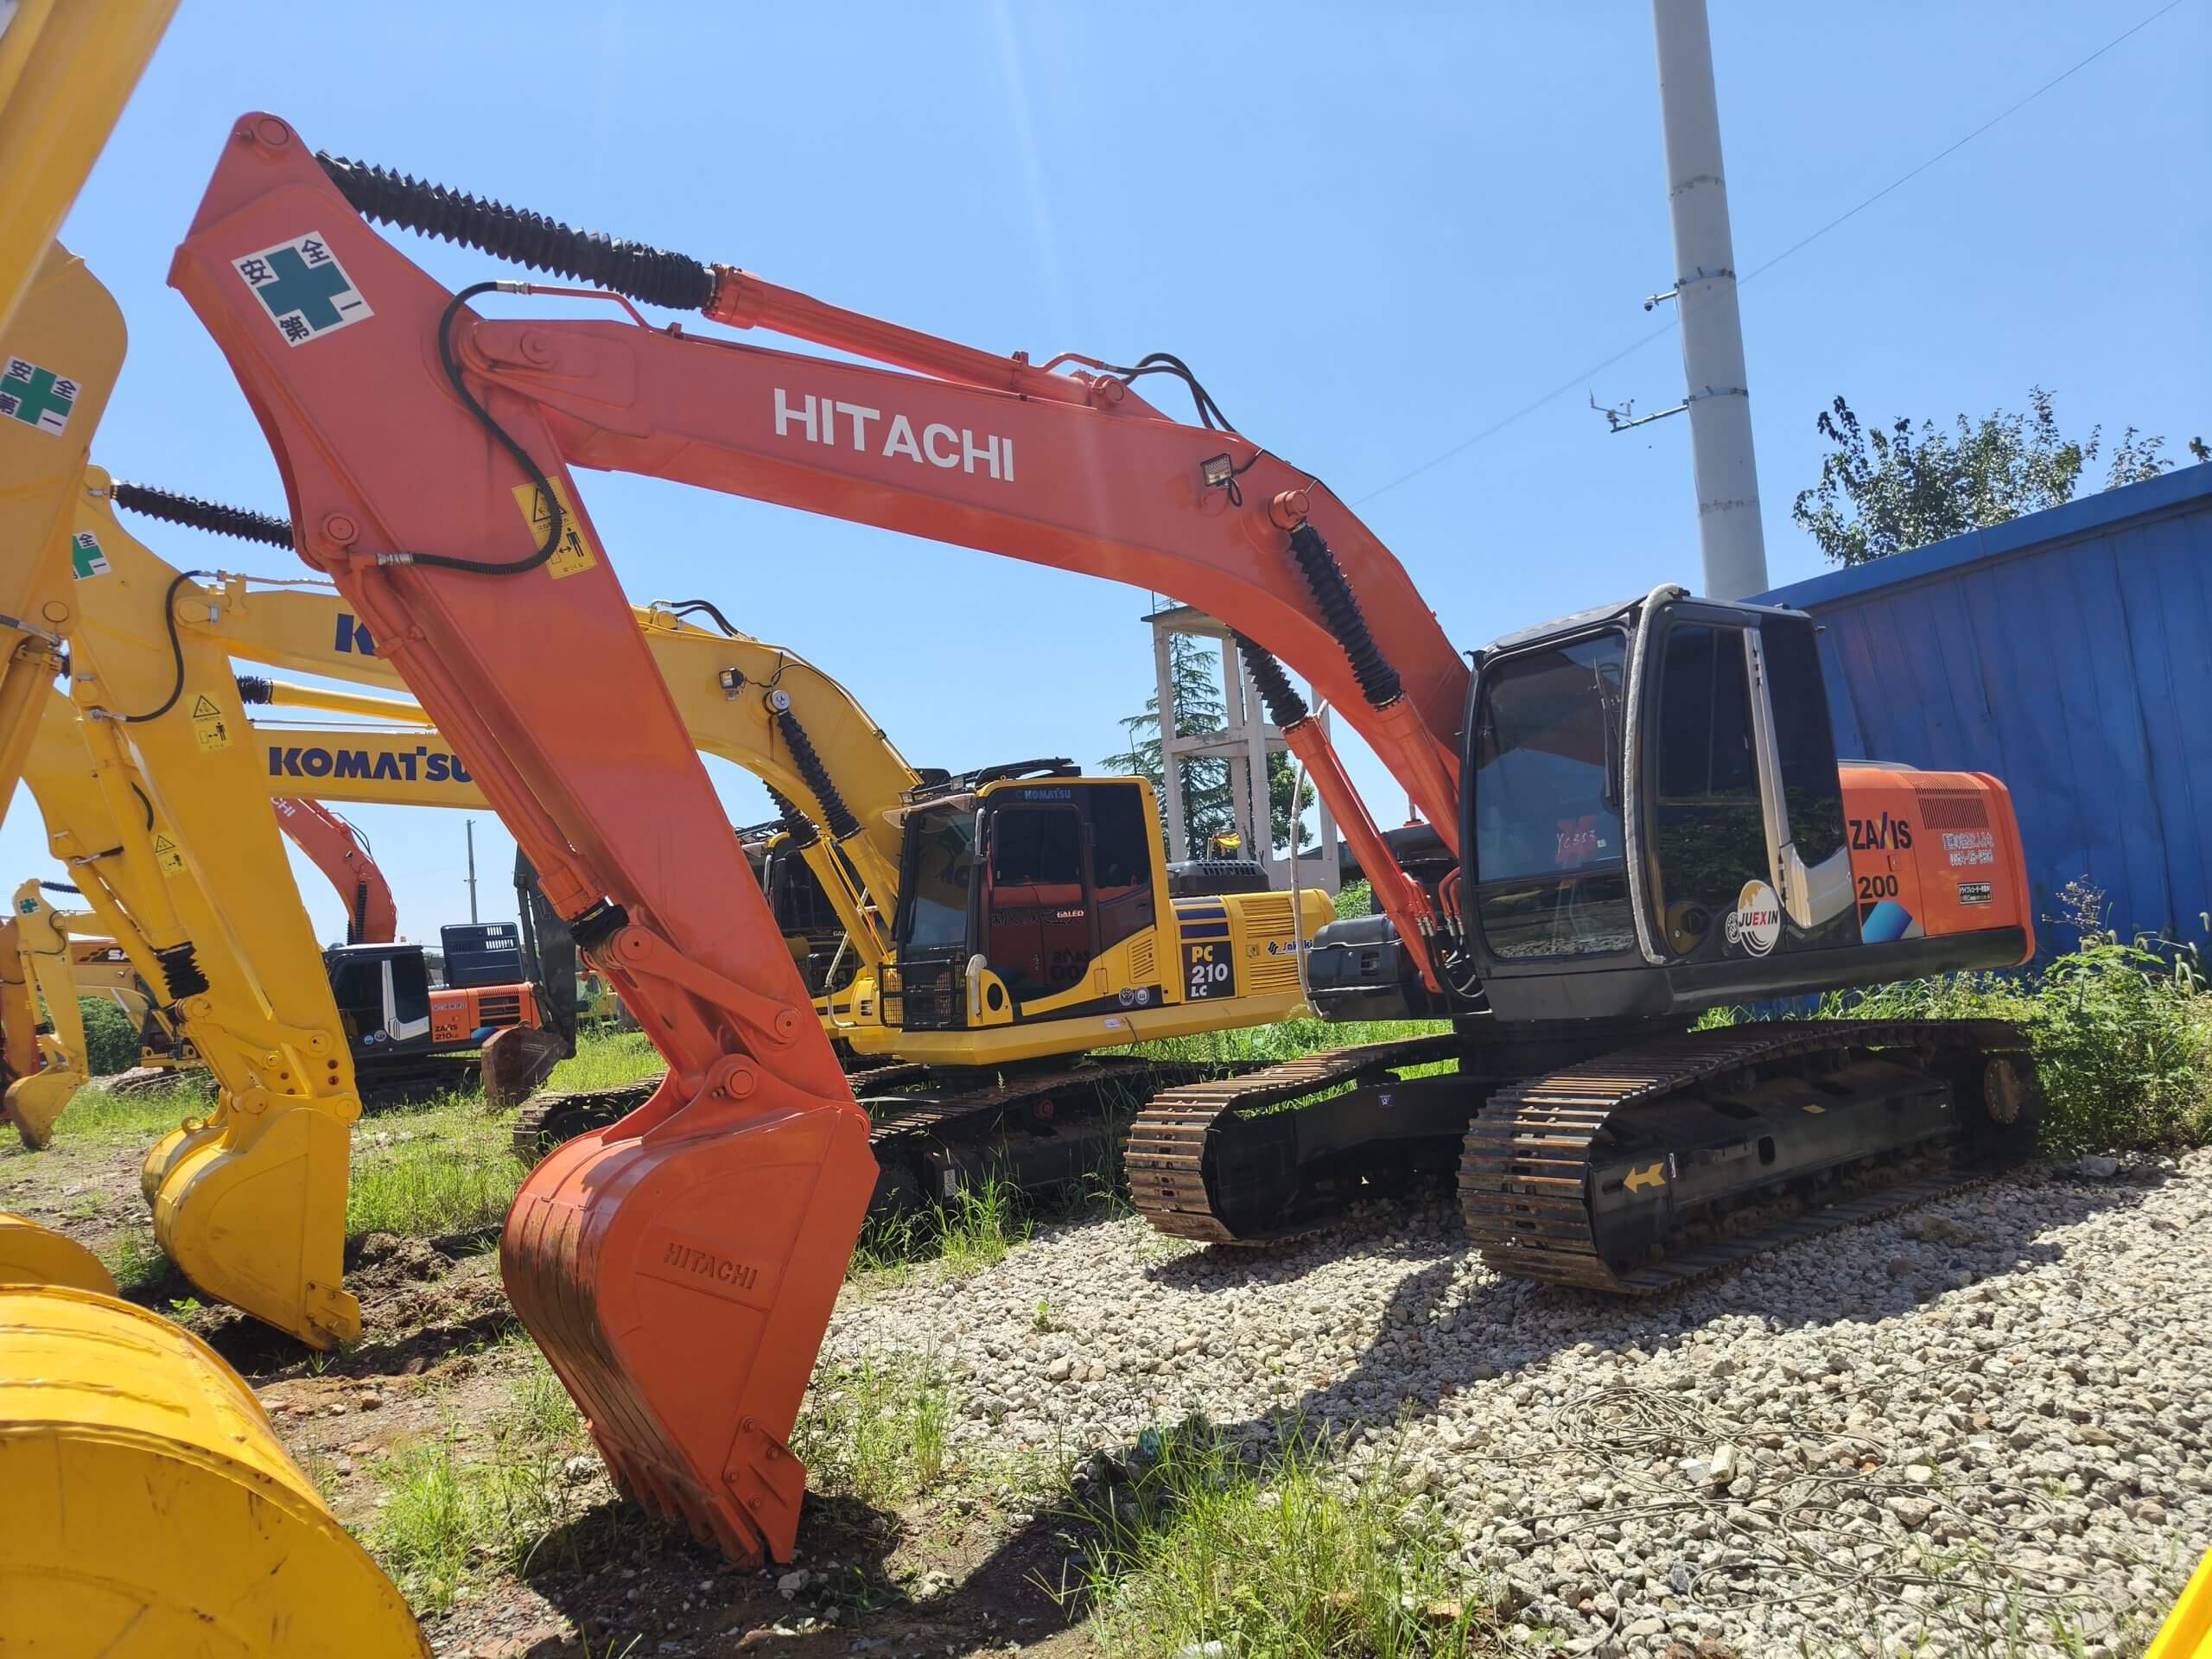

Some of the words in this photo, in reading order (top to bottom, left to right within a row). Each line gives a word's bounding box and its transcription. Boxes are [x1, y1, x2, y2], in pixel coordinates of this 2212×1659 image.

[773, 387, 1014, 482] HITACHI
[1023, 787, 1071, 800] KOMATSU
[1849, 811, 1912, 850] ZAXIS
[1858, 874, 1898, 899] 200
[1739, 910, 1778, 927] JUEXIN
[1192, 945, 1213, 963] PC
[1191, 963, 1229, 984] 210
[1191, 985, 1207, 997] LC
[663, 1243, 759, 1291] HITACHI
